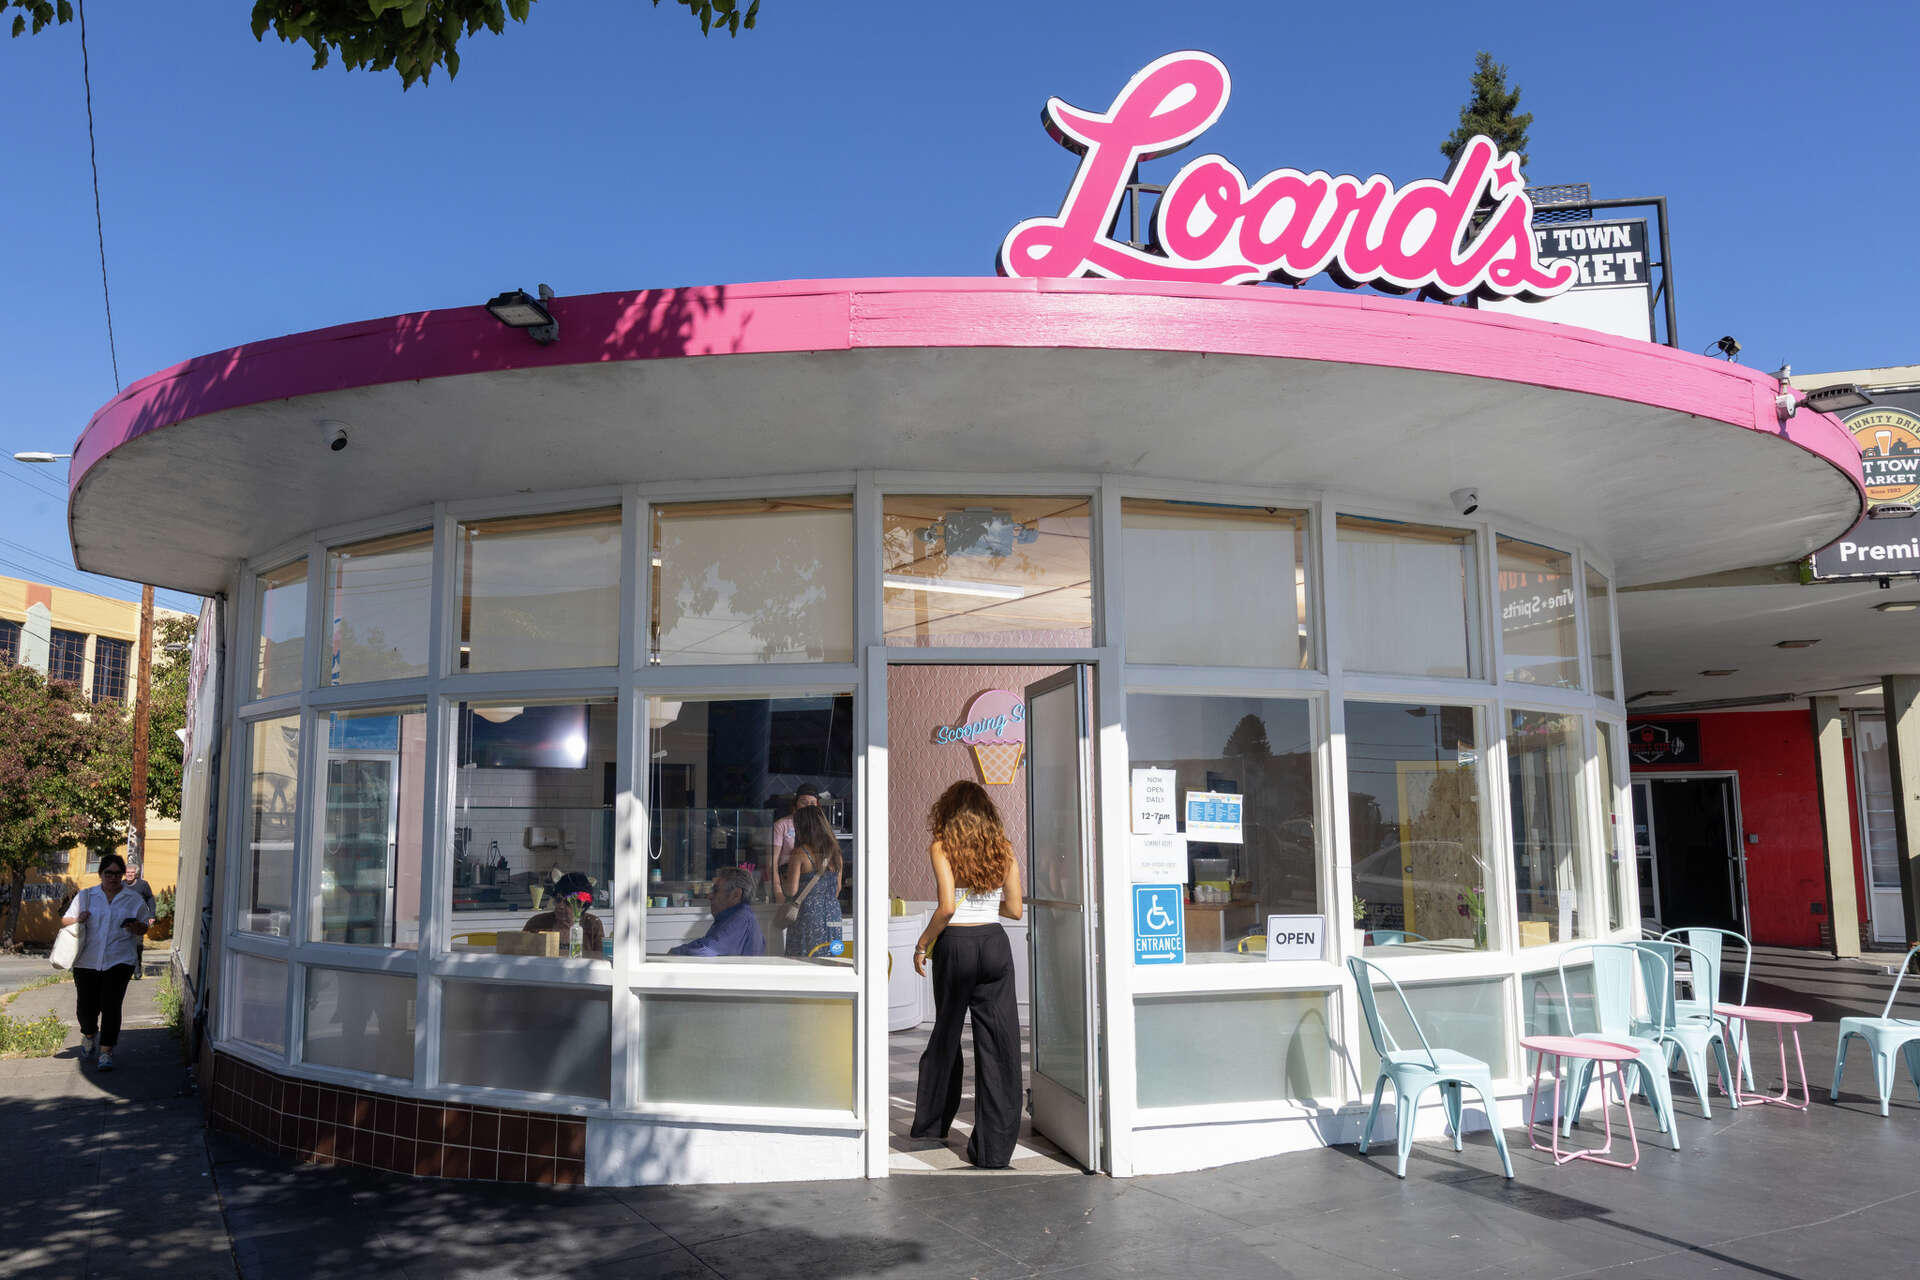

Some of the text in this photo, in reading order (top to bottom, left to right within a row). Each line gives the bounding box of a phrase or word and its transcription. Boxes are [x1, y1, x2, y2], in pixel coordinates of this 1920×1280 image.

[1552, 225, 1632, 252] TOWN
[1539, 251, 1643, 284] KET
[1878, 458, 1920, 473] TOW
[1865, 473, 1916, 486] ARKET
[1840, 537, 1920, 562] Premi
[936, 713, 1008, 745] Scooping
[1146, 776, 1163, 784] NOW
[1146, 786, 1164, 794] OPEN
[1136, 937, 1183, 952] ENTRANCE
[1276, 932, 1316, 946] OPEN
